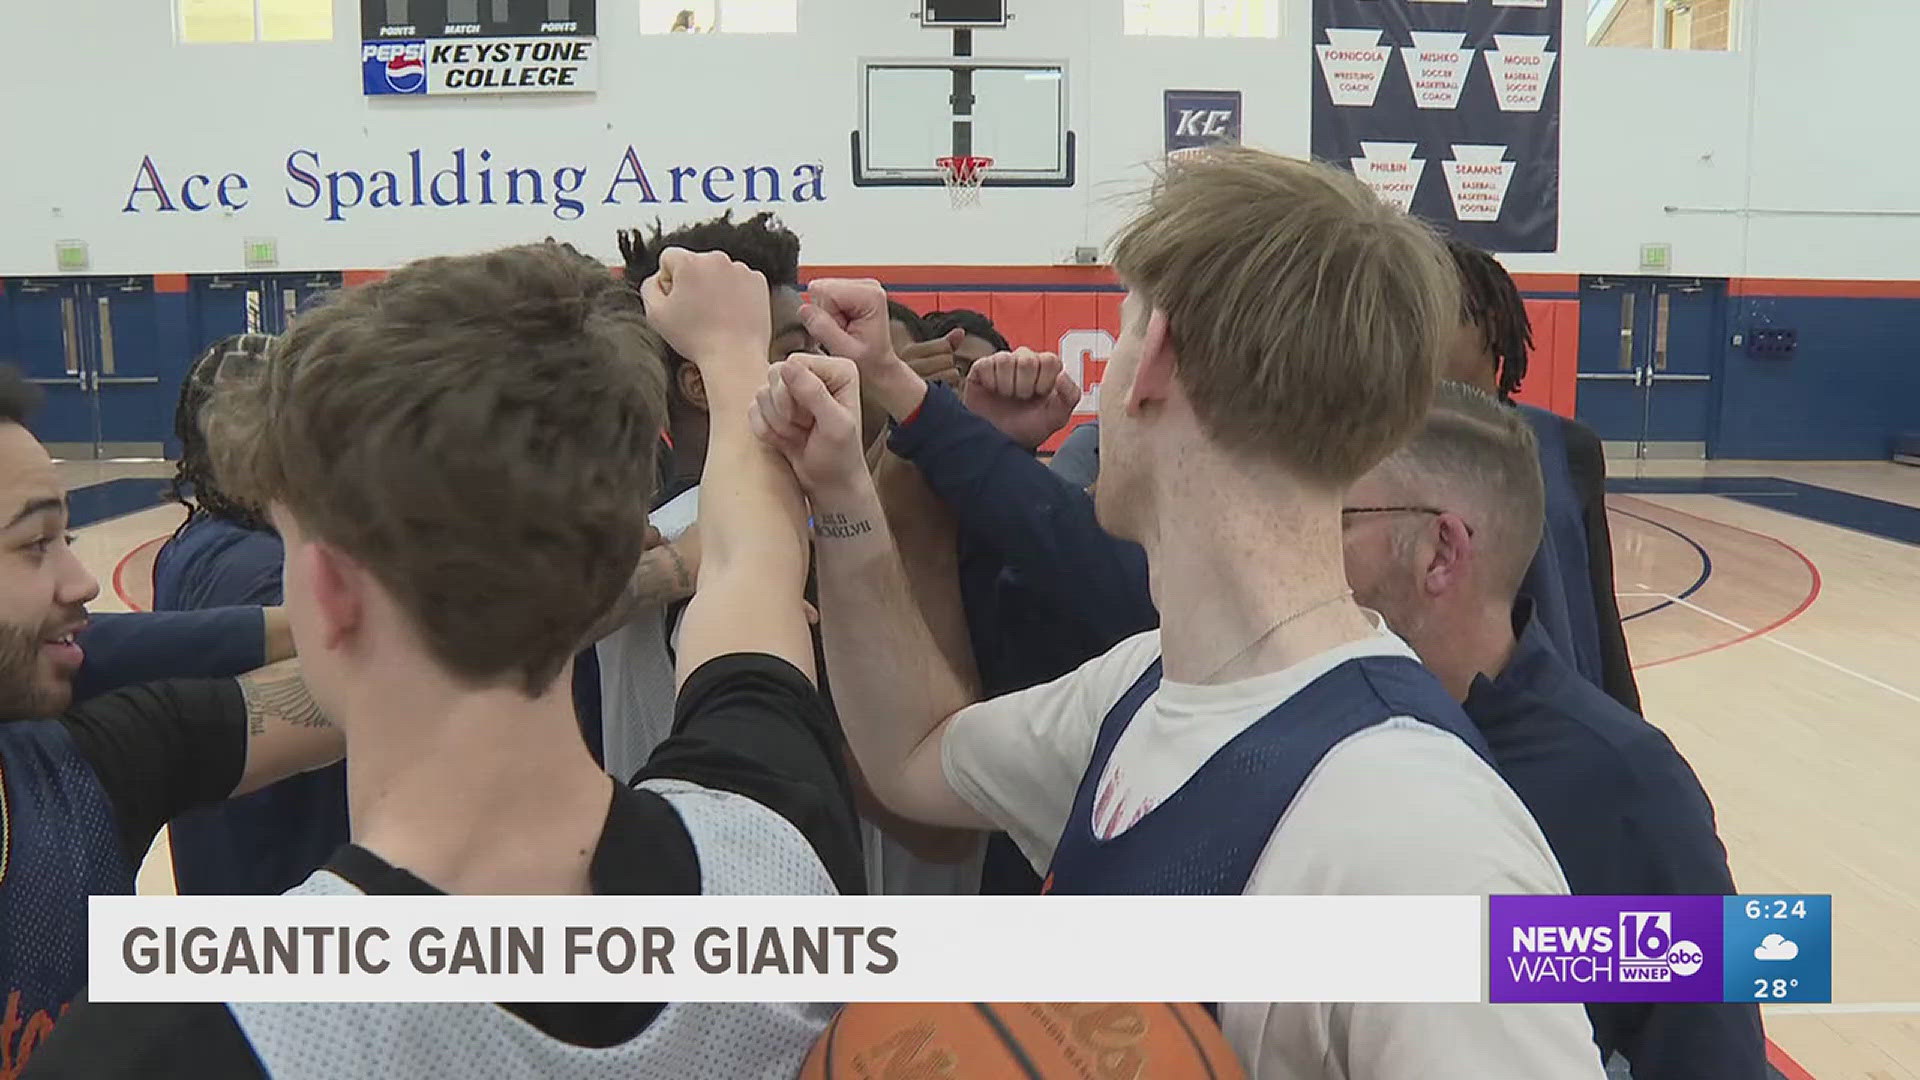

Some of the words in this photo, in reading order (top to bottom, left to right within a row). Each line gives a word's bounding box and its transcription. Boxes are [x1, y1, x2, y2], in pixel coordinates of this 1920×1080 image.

[379, 25, 416, 36] POINTS
[444, 24, 481, 35] MATCH
[541, 22, 577, 33] POINTS
[363, 43, 425, 62] PEPSI
[431, 42, 592, 64] KEYSTONE
[1324, 51, 1385, 62] FORNICOLA
[1419, 53, 1459, 63] MISHKO
[1504, 56, 1540, 66] MOULD
[445, 67, 578, 88] COLLEGE
[1333, 72, 1375, 81] WRESTLING
[1422, 70, 1453, 78] SOCCER
[1504, 72, 1539, 81] BASEBALL
[1339, 83, 1369, 92] COACH
[1416, 81, 1458, 90] BASKETBALL
[1506, 84, 1537, 92] SOCCER
[1422, 93, 1452, 101] COACH
[1506, 95, 1536, 103] COACH
[1370, 162, 1408, 172] PHILBIN
[1455, 165, 1503, 175] SEAMANS
[122, 154, 249, 212] Ace
[285, 148, 588, 222] Spalding
[600, 144, 828, 205] Arena
[1462, 182, 1497, 190] BASEBALL
[1457, 193, 1500, 201] BASKETBALL
[1459, 204, 1498, 213] FOOTBALL
